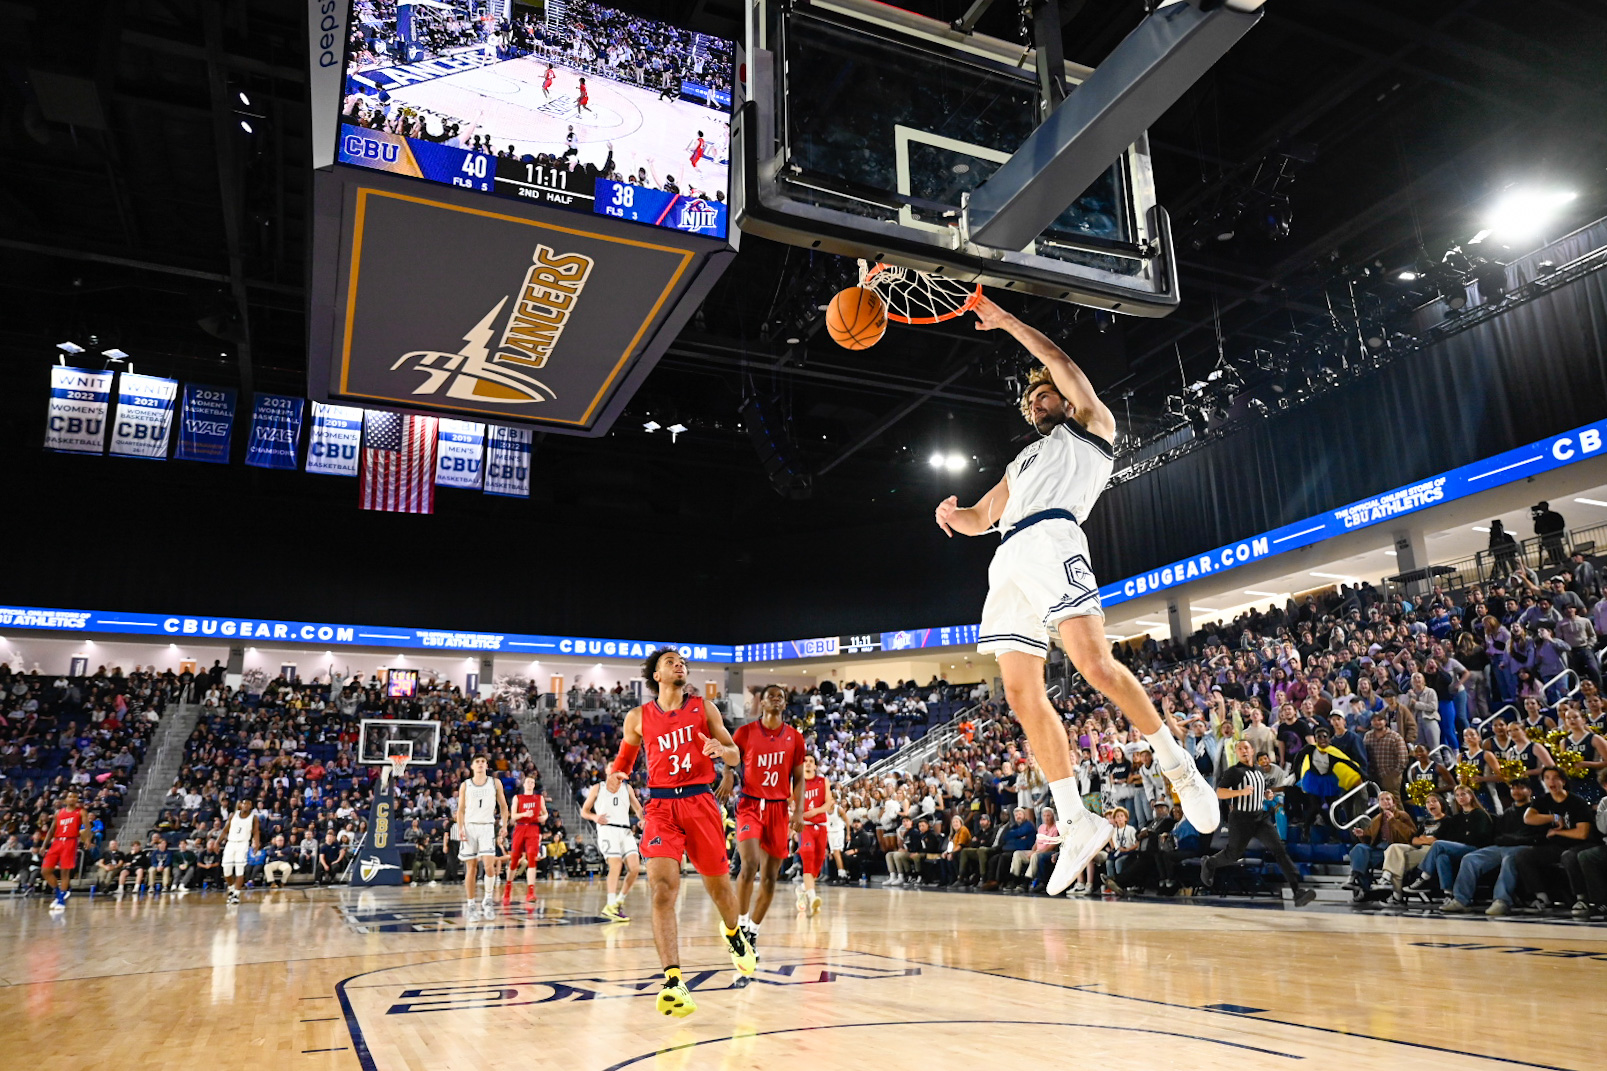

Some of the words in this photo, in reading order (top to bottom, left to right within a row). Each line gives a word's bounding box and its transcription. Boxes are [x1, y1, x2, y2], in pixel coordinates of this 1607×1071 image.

[319, 0, 339, 68] peps
[344, 134, 399, 163] CBU
[462, 153, 488, 179] 40
[453, 177, 473, 188] FLS
[481, 182, 488, 191] 5
[525, 163, 567, 190] 11:11
[518, 187, 540, 199] 2ND
[546, 194, 574, 205] HALF
[612, 184, 634, 207] 38
[606, 206, 624, 217] FLS
[632, 211, 638, 220] 3
[679, 209, 717, 232] NJIT
[493, 243, 595, 369] LANCERS
[60, 375, 106, 389] WNIT
[127, 382, 171, 396] WNIT
[67, 390, 95, 400] 2022
[134, 397, 159, 407] 2021
[196, 389, 226, 401] 2021
[263, 397, 292, 408] 2021
[51, 403, 105, 416] WOMEN'S
[185, 405, 234, 417] BASKETBALL
[190, 400, 228, 410] WOMEN'S
[257, 407, 294, 417] WOMEN'S
[127, 408, 164, 418] WOMEN'S
[49, 416, 102, 435] CBU
[185, 419, 229, 437] WAC
[325, 419, 348, 428] 2019
[118, 422, 166, 441] CBU
[256, 426, 295, 443] WAC
[314, 431, 358, 441] WOMEN'S
[452, 434, 473, 443] 2019
[497, 428, 524, 439] CBI
[46, 435, 103, 447] BASKETBALL
[1552, 428, 1602, 461] CB
[312, 442, 356, 460] CBU
[448, 446, 474, 454] MEN'S
[308, 461, 356, 471] BASKETBALL
[440, 456, 481, 473] CBU
[489, 463, 528, 481] CBU
[1334, 510, 1349, 519] THE
[1349, 499, 1380, 516] OFFICIAL
[1380, 491, 1409, 507] ONLINE
[1409, 480, 1434, 496] STORE
[1433, 477, 1446, 487] OF
[1343, 510, 1370, 528] CBU
[1371, 486, 1444, 520] ATHLETICS
[1124, 537, 1269, 597] CBUGEAR.COM
[13, 615, 86, 628] ATHLETICS
[163, 618, 354, 642] CBUGEAR.COM
[423, 637, 444, 646] CBU
[445, 638, 501, 649] ATHLETICS
[805, 640, 835, 653] CBU
[850, 635, 871, 647] 11:11
[391, 680, 413, 697] 29
[657, 724, 694, 754] NJIT
[668, 753, 693, 777] 34
[757, 750, 786, 770] NJIT
[762, 771, 779, 788] 20
[479, 799, 482, 808] 1
[613, 797, 618, 806] 0
[374, 802, 390, 849] CBU
